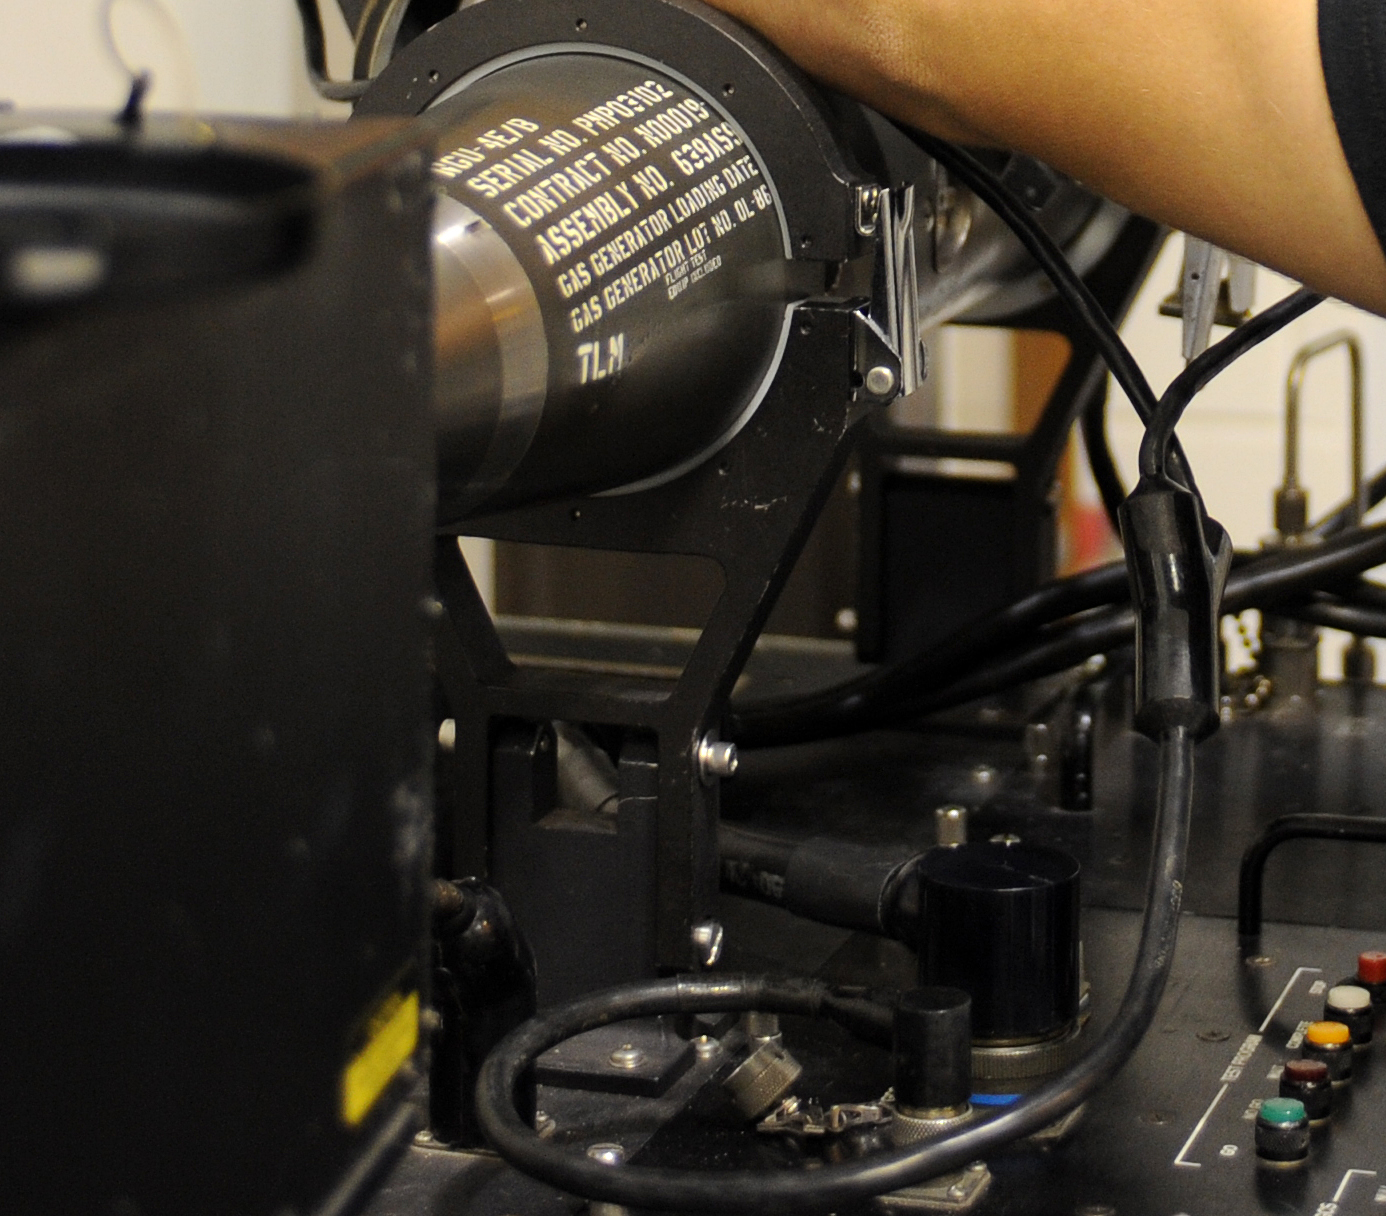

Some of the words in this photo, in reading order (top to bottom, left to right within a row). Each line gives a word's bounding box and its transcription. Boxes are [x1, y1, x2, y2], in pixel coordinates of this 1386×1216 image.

[467, 149, 555, 198] SERIAL
[503, 152, 612, 228] CONTRACT
[535, 181, 640, 265] ASSEMBLY
[558, 265, 592, 298] GAS
[590, 209, 672, 268] GENERATOR
[668, 175, 727, 223] LOADING
[726, 155, 759, 195] DATE
[570, 300, 602, 333] GAS
[605, 239, 685, 311] GENERATOR
[684, 222, 712, 255] LOT
[577, 333, 625, 384] TLM
